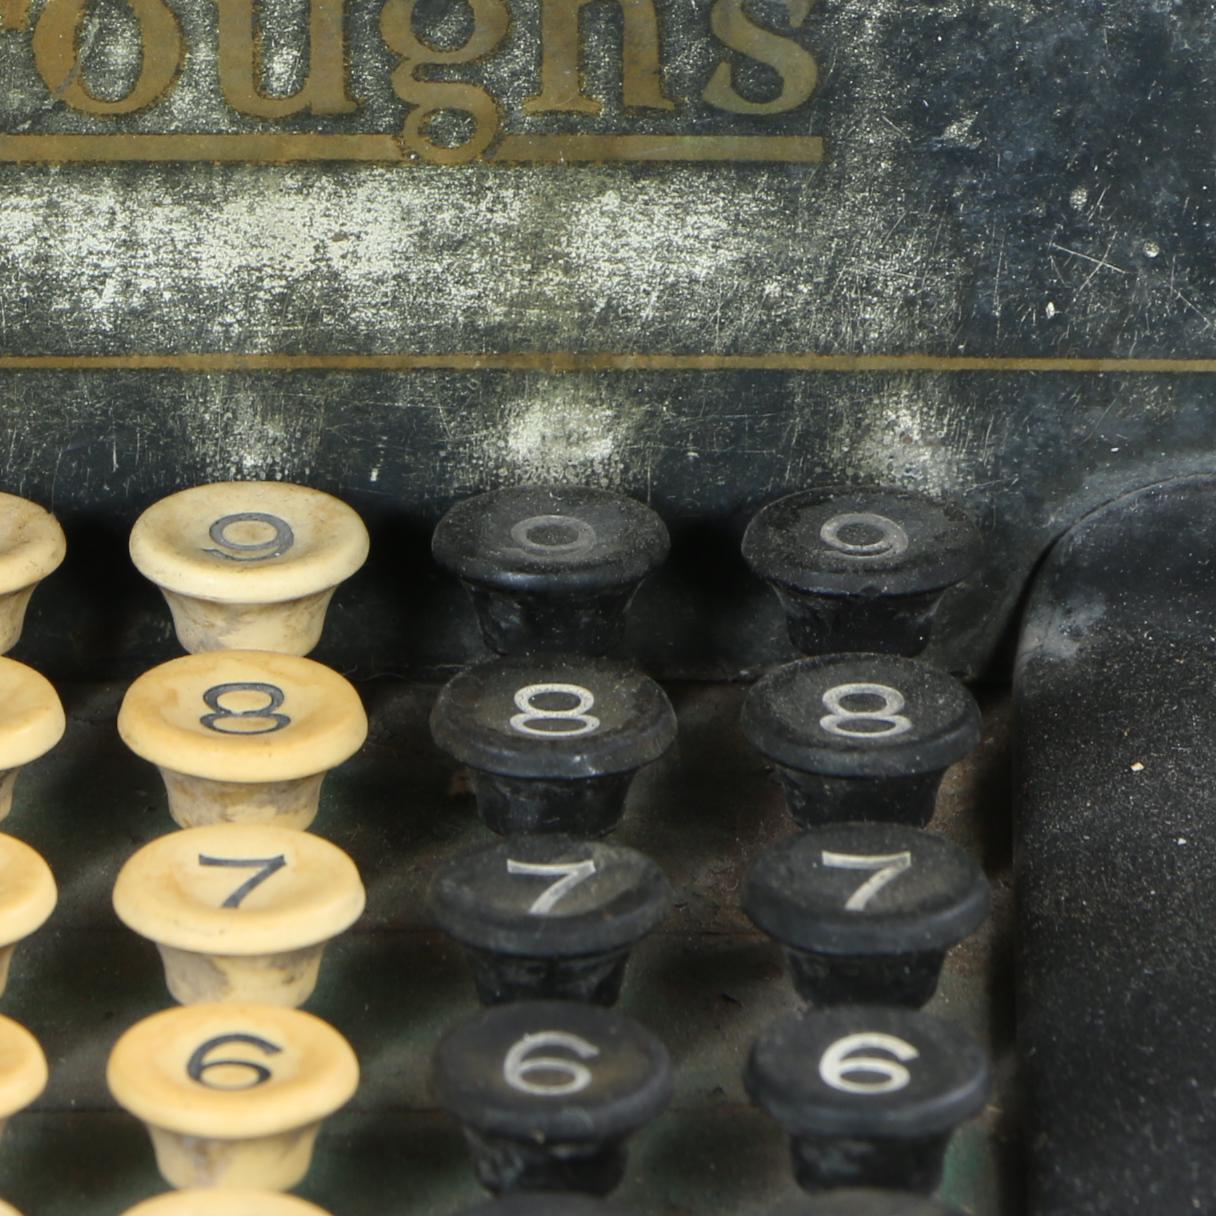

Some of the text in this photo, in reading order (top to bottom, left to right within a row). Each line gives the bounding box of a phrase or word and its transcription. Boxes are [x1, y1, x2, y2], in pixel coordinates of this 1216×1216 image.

[202, 512, 295, 562] 9
[199, 682, 291, 735] 8
[509, 683, 600, 737] 8
[819, 683, 912, 738] 8
[198, 853, 286, 910] 7
[506, 858, 596, 916] 7
[821, 850, 911, 911] 7
[186, 1033, 282, 1092] 6
[503, 1029, 599, 1097] 6
[818, 1032, 920, 1096] 6
